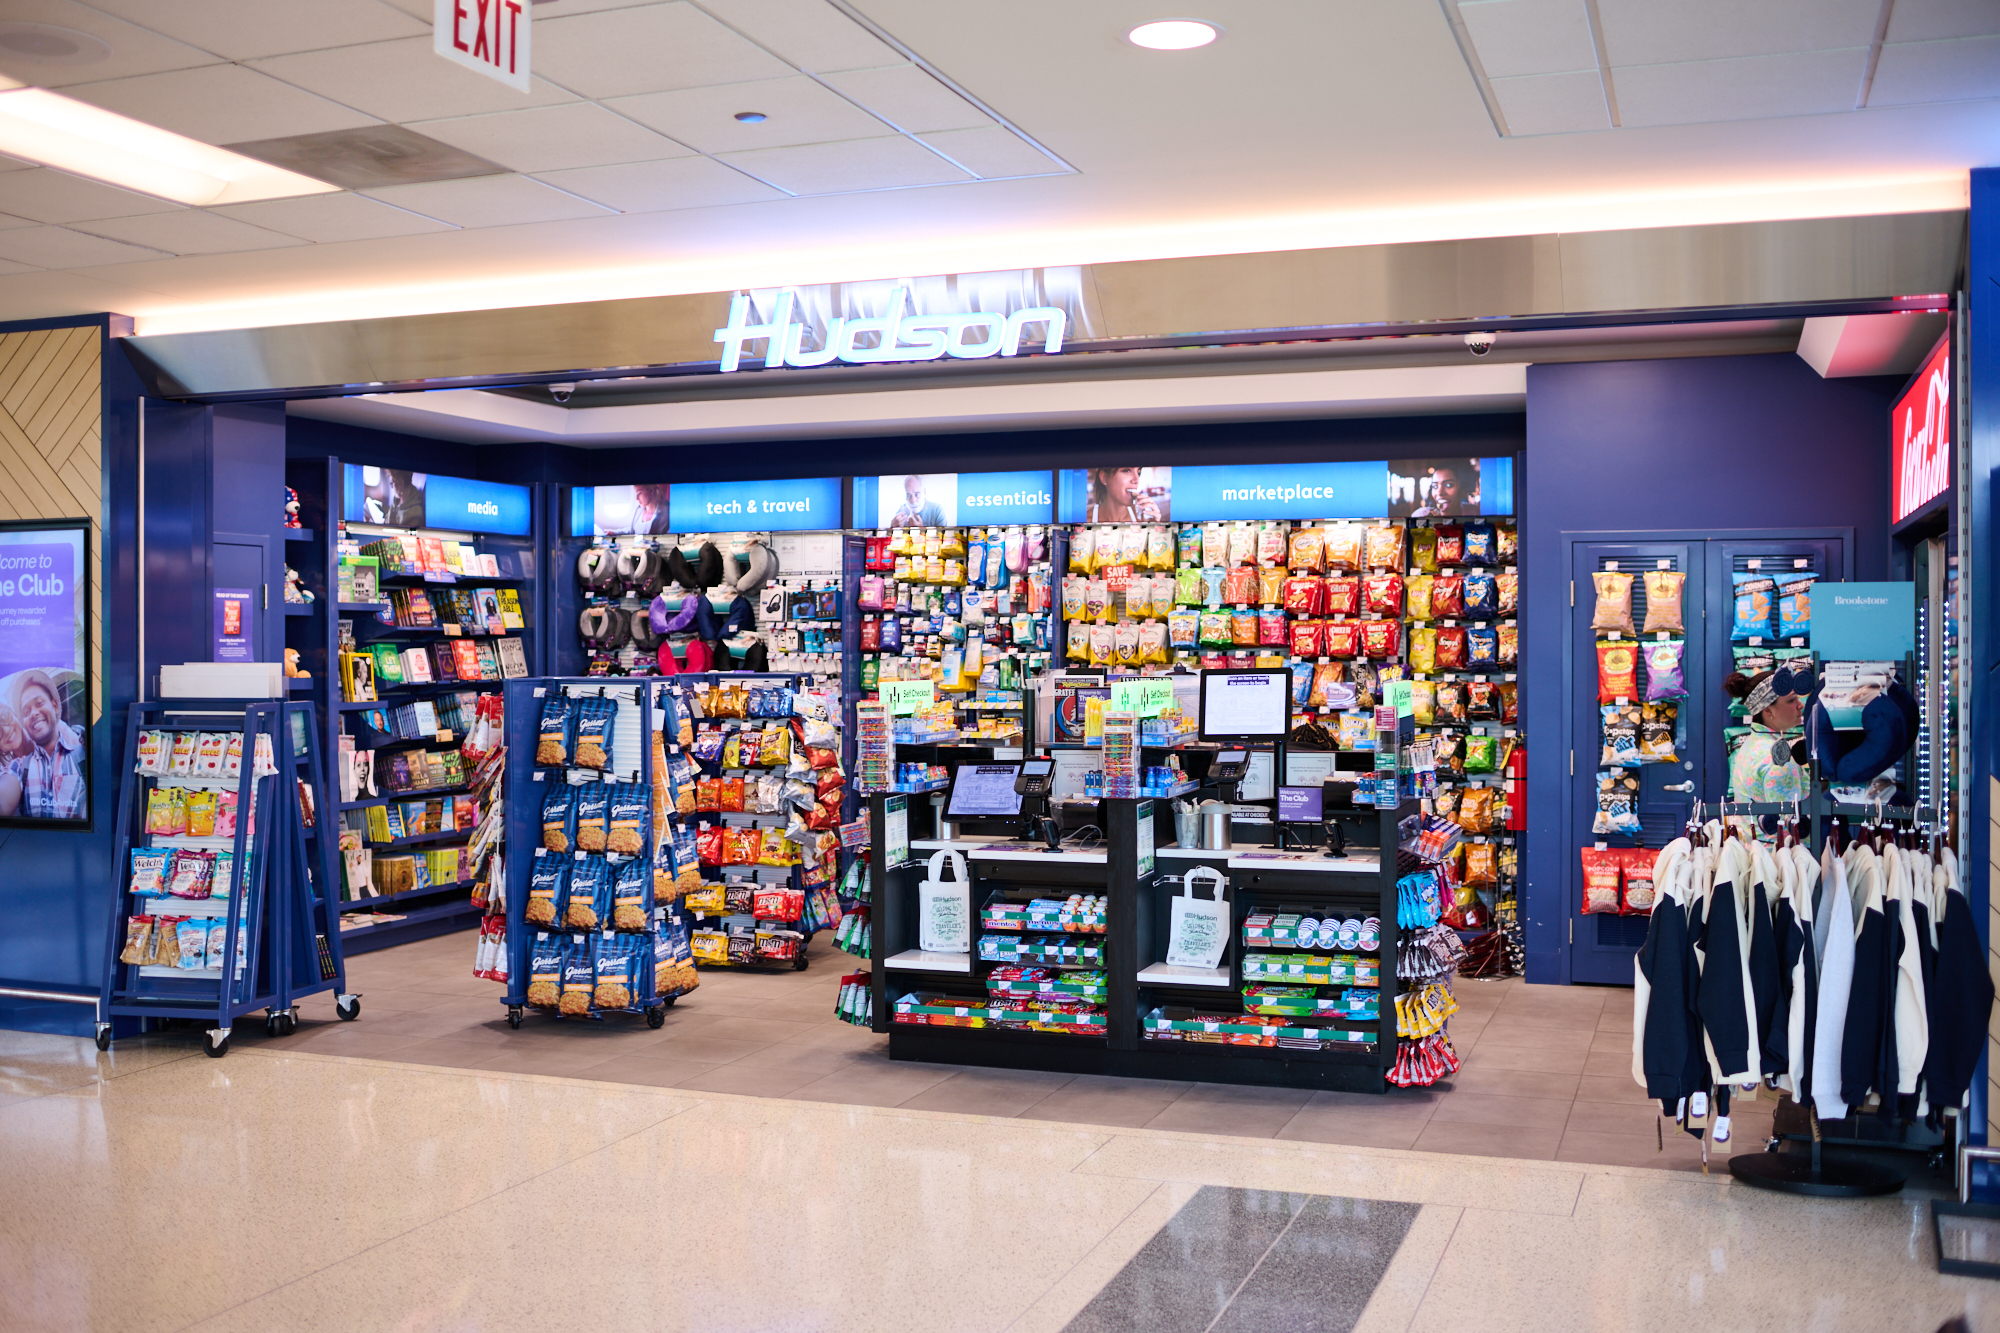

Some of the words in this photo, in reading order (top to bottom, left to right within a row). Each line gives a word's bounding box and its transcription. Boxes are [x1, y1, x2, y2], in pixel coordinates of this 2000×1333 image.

[453, 0, 521, 74] EXIT
[714, 288, 1066, 372] Hudson
[965, 490, 1051, 507] essentials
[1222, 483, 1334, 503] marketplace
[467, 500, 499, 516] media
[706, 500, 742, 515] tech
[746, 499, 757, 513] &
[762, 497, 810, 513] travel
[39, 553, 52, 568] to
[1107, 566, 1129, 577] SAVE
[18, 573, 64, 596] Club
[1107, 577, 1128, 585] $2.00
[1834, 596, 1888, 605] Brookstone
[386, 656, 396, 665] LET
[385, 665, 400, 673] THEM
[1379, 666, 1403, 682] Takis
[912, 689, 930, 697] Checkout
[1651, 732, 1670, 747] NACHO
[227, 749, 242, 757] FAVE
[1599, 793, 1631, 802] popchips
[611, 804, 643, 817] Garrett
[134, 858, 163, 867] Welch's
[218, 861, 232, 870] Welc
[532, 957, 562, 971] Garrett
[597, 957, 629, 972] Garrett
[565, 967, 593, 980] Garrett
